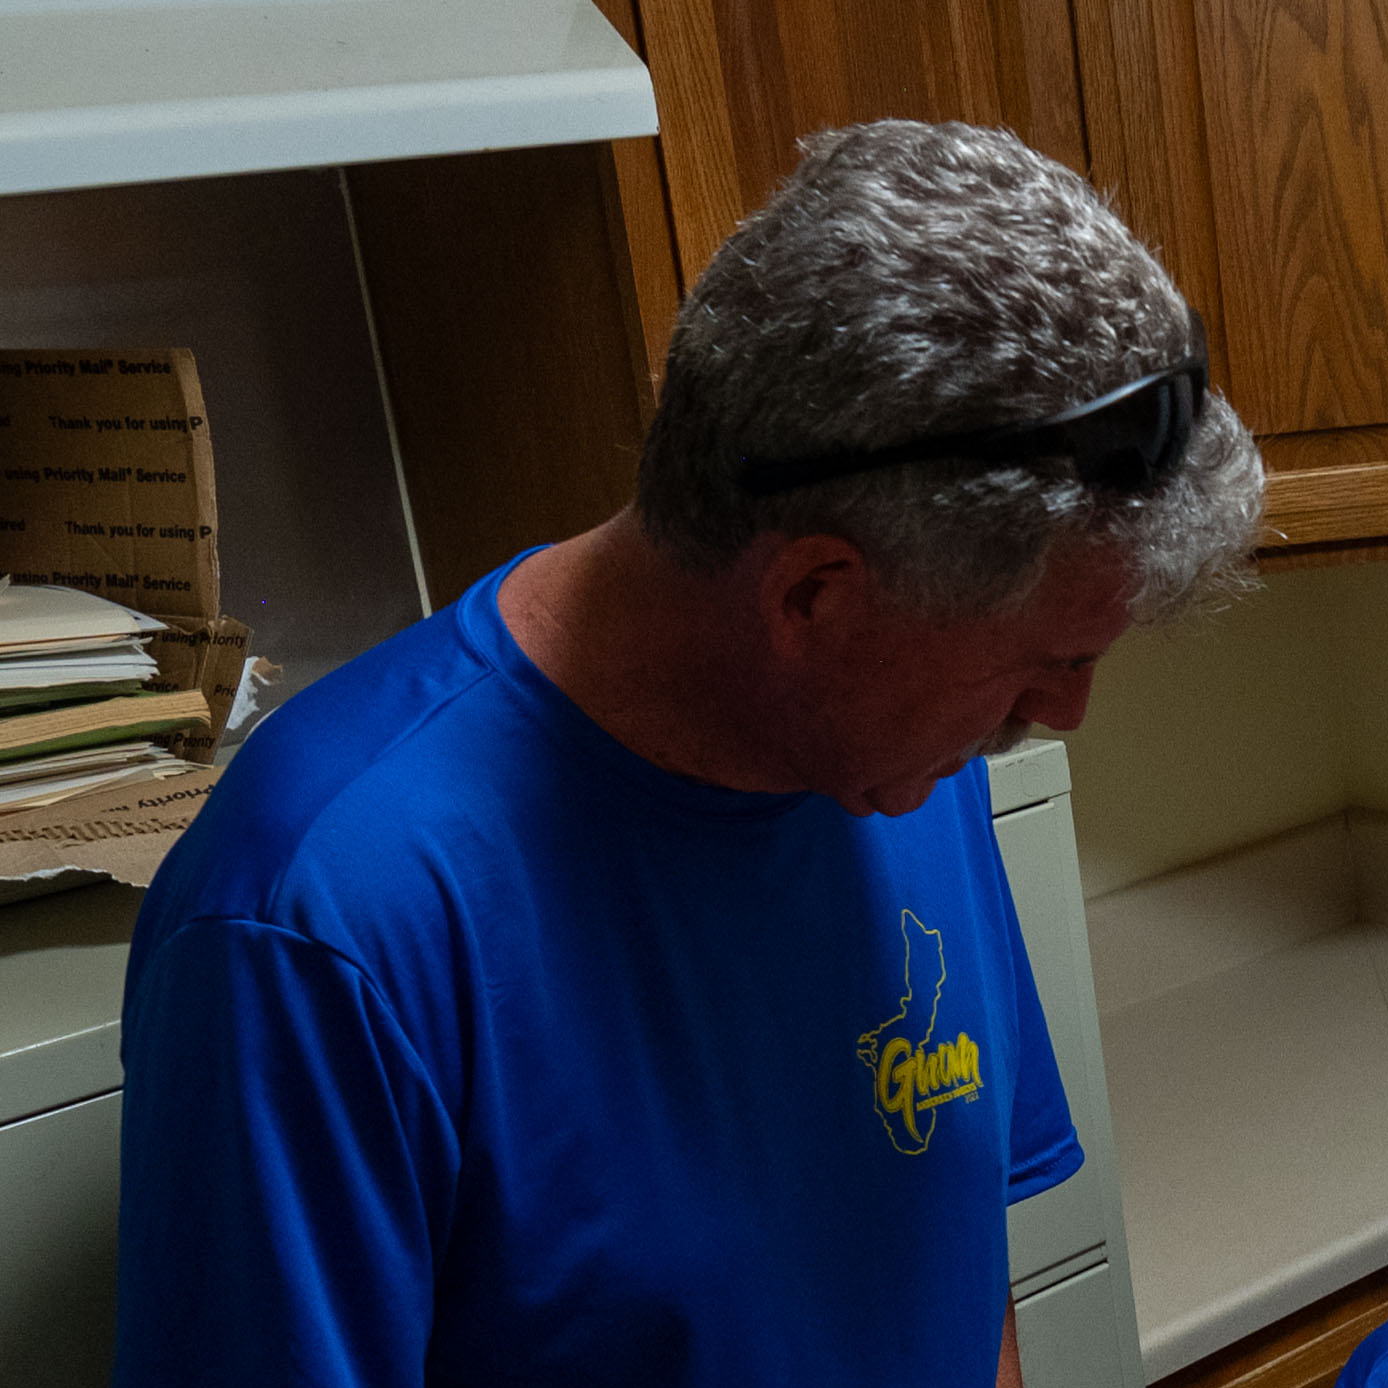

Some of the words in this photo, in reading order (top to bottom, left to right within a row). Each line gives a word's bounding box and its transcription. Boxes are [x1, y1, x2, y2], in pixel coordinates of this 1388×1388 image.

[25, 359, 75, 376] Priority
[118, 360, 171, 375] Service
[48, 416, 92, 430] Thank
[96, 417, 122, 432] you
[125, 416, 145, 430] for
[149, 417, 187, 433] using
[4, 469, 40, 483] using
[43, 468, 94, 483] Priority
[136, 469, 186, 483] Service
[64, 520, 105, 535] Thank
[109, 523, 134, 537] you
[136, 523, 154, 537] for
[159, 524, 195, 541] using
[52, 571, 101, 590] Priority
[143, 575, 191, 591] Service
